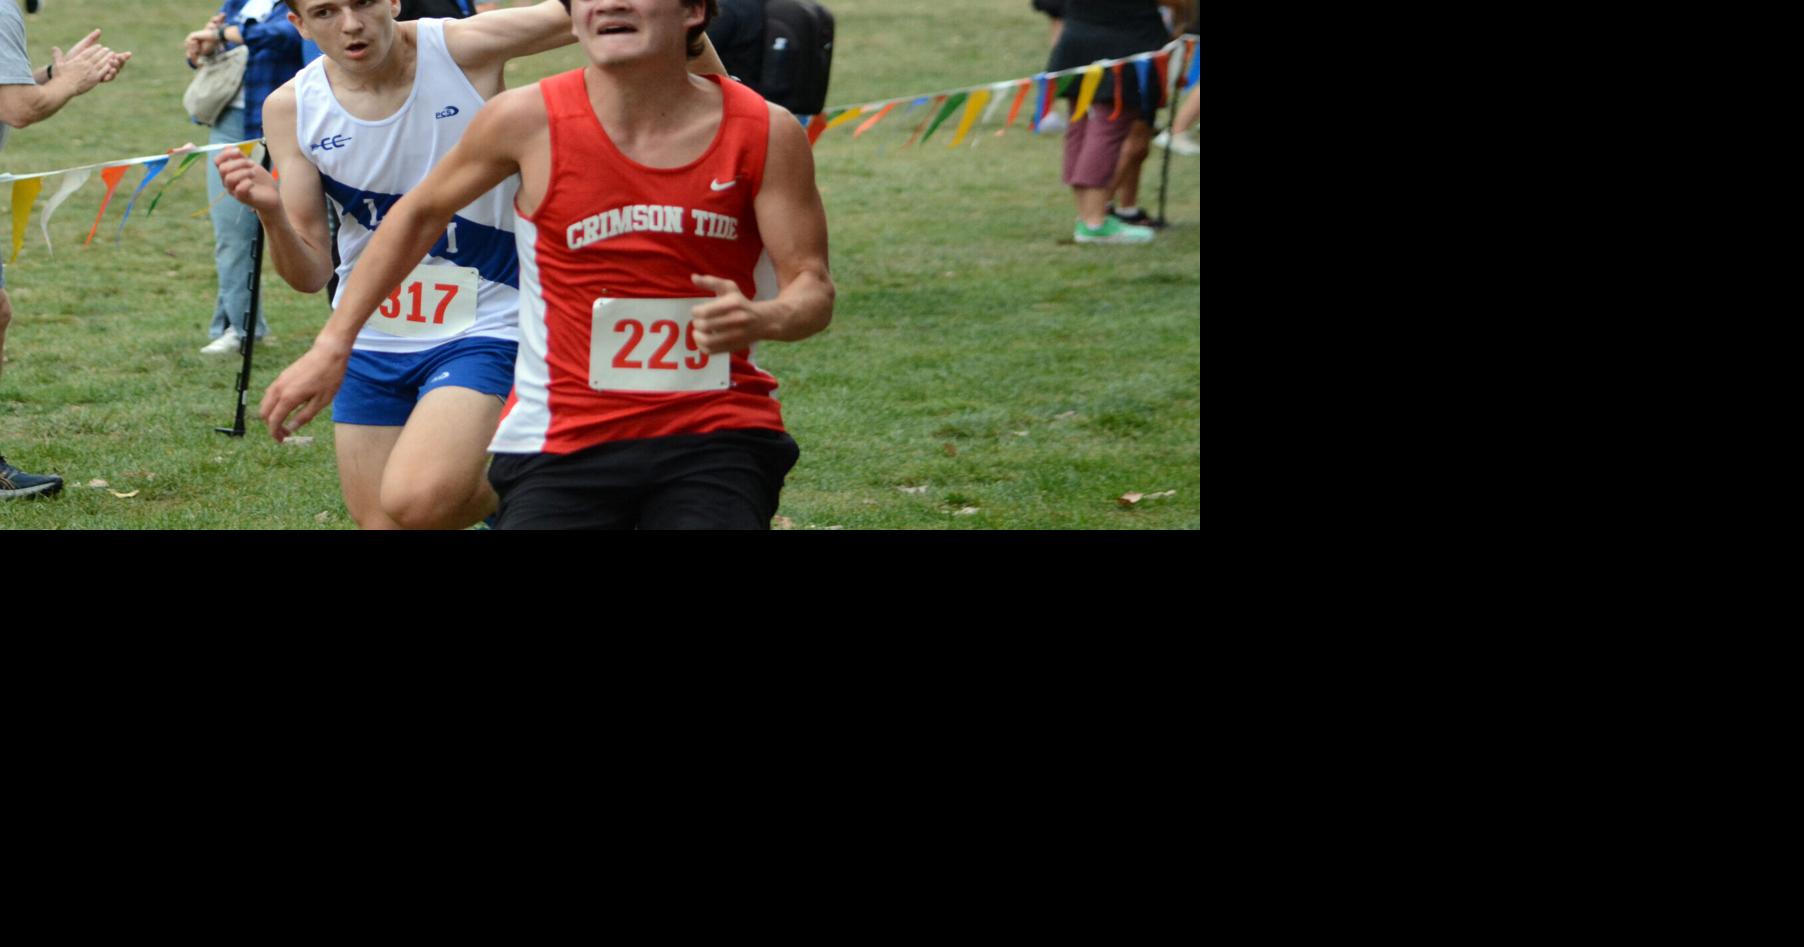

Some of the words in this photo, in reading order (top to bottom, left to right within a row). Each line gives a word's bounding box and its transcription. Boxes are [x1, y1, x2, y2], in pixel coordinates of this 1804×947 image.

[566, 204, 684, 250] CRIMSON
[691, 208, 738, 240] TIDE
[379, 281, 459, 324] 317
